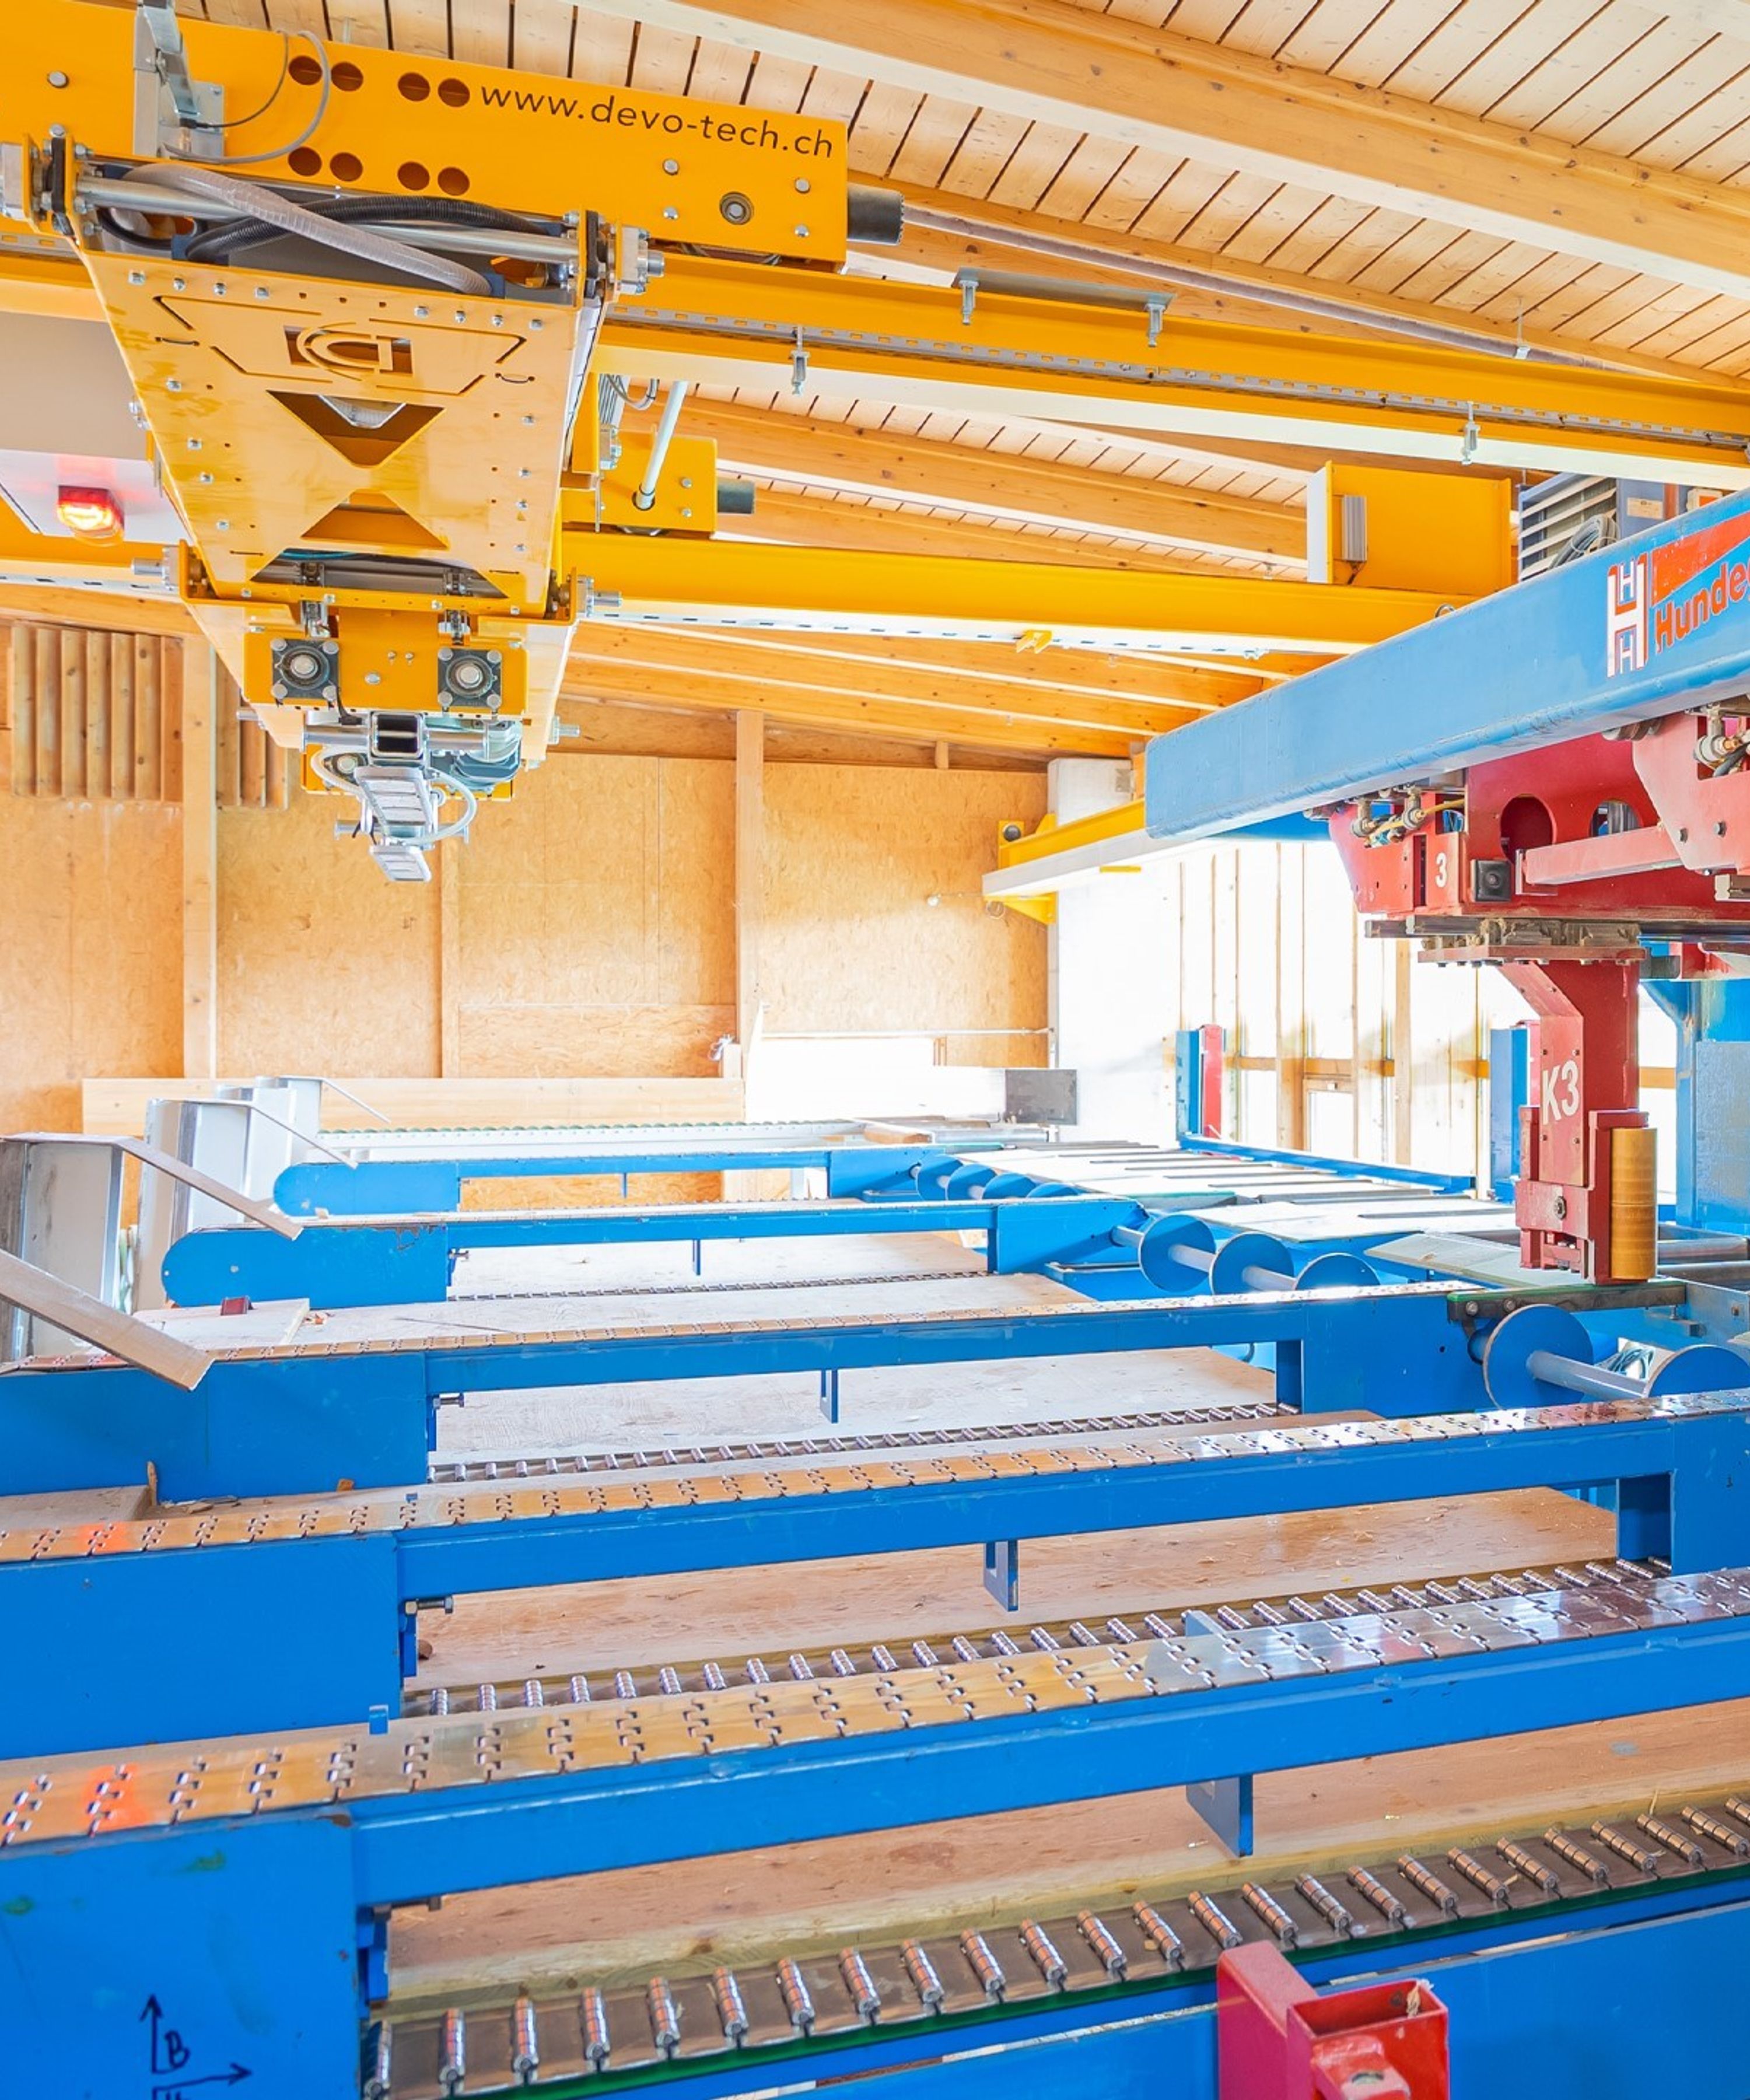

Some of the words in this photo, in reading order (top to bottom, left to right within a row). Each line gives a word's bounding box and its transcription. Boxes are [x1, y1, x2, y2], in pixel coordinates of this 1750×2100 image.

[481, 86, 832, 158] www.devo-tech.ch
[1655, 556, 1750, 653] Hunde
[1435, 852, 1448, 888] 3
[1542, 1060, 1579, 1125] K3
[164, 2030, 191, 2068] B
